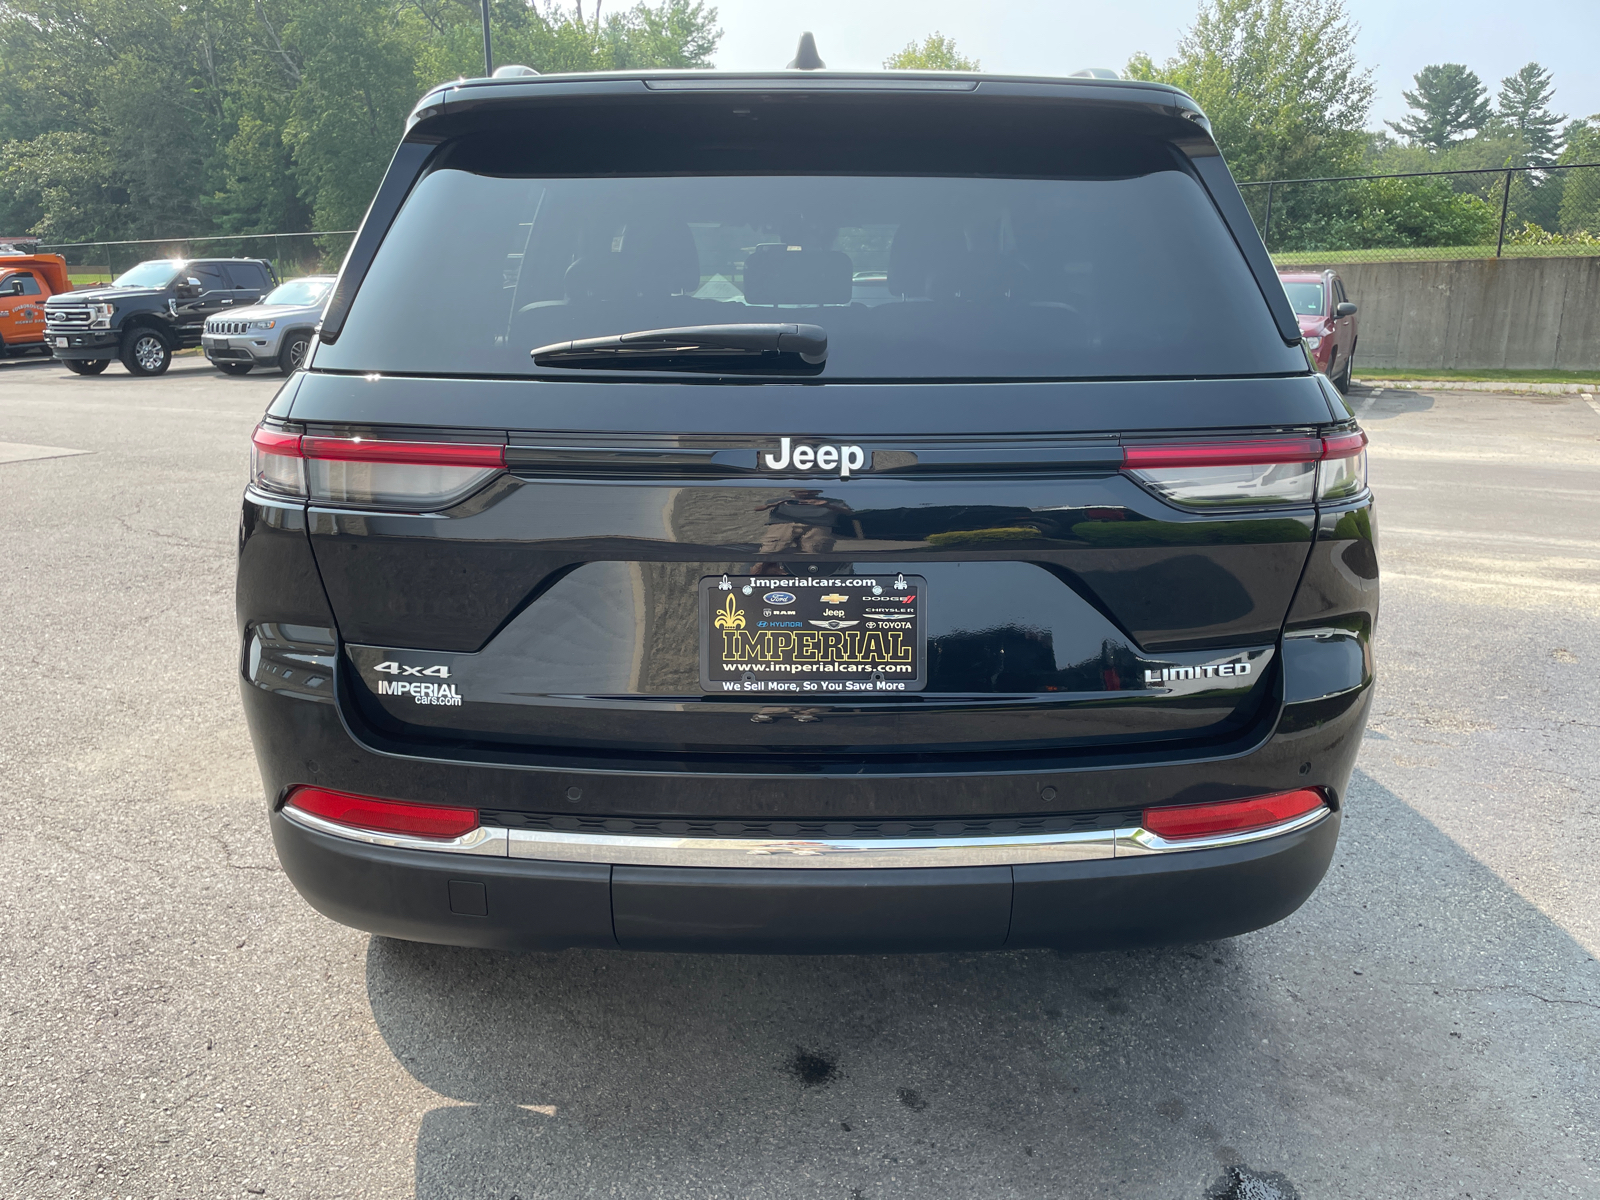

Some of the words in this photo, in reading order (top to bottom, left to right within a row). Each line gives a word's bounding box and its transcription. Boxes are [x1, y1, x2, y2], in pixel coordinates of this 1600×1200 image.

[764, 437, 865, 477] Jeep
[750, 577, 876, 589] Imperialcars.com
[770, 594, 790, 603] Ford
[823, 608, 845, 618] Jeep
[878, 621, 912, 629] TOYOTA
[722, 630, 912, 662] IMPERIAL
[722, 662, 912, 674] www.imperialcars.com
[1144, 663, 1252, 683] LIMITED
[378, 680, 462, 698] IMPERIAL
[722, 681, 741, 691] We
[743, 681, 765, 691] Sell
[768, 681, 800, 693] More,
[803, 681, 818, 691] So
[821, 681, 843, 691] You
[845, 681, 874, 691] Save
[876, 681, 905, 691] More
[415, 696, 462, 706] cars.com
